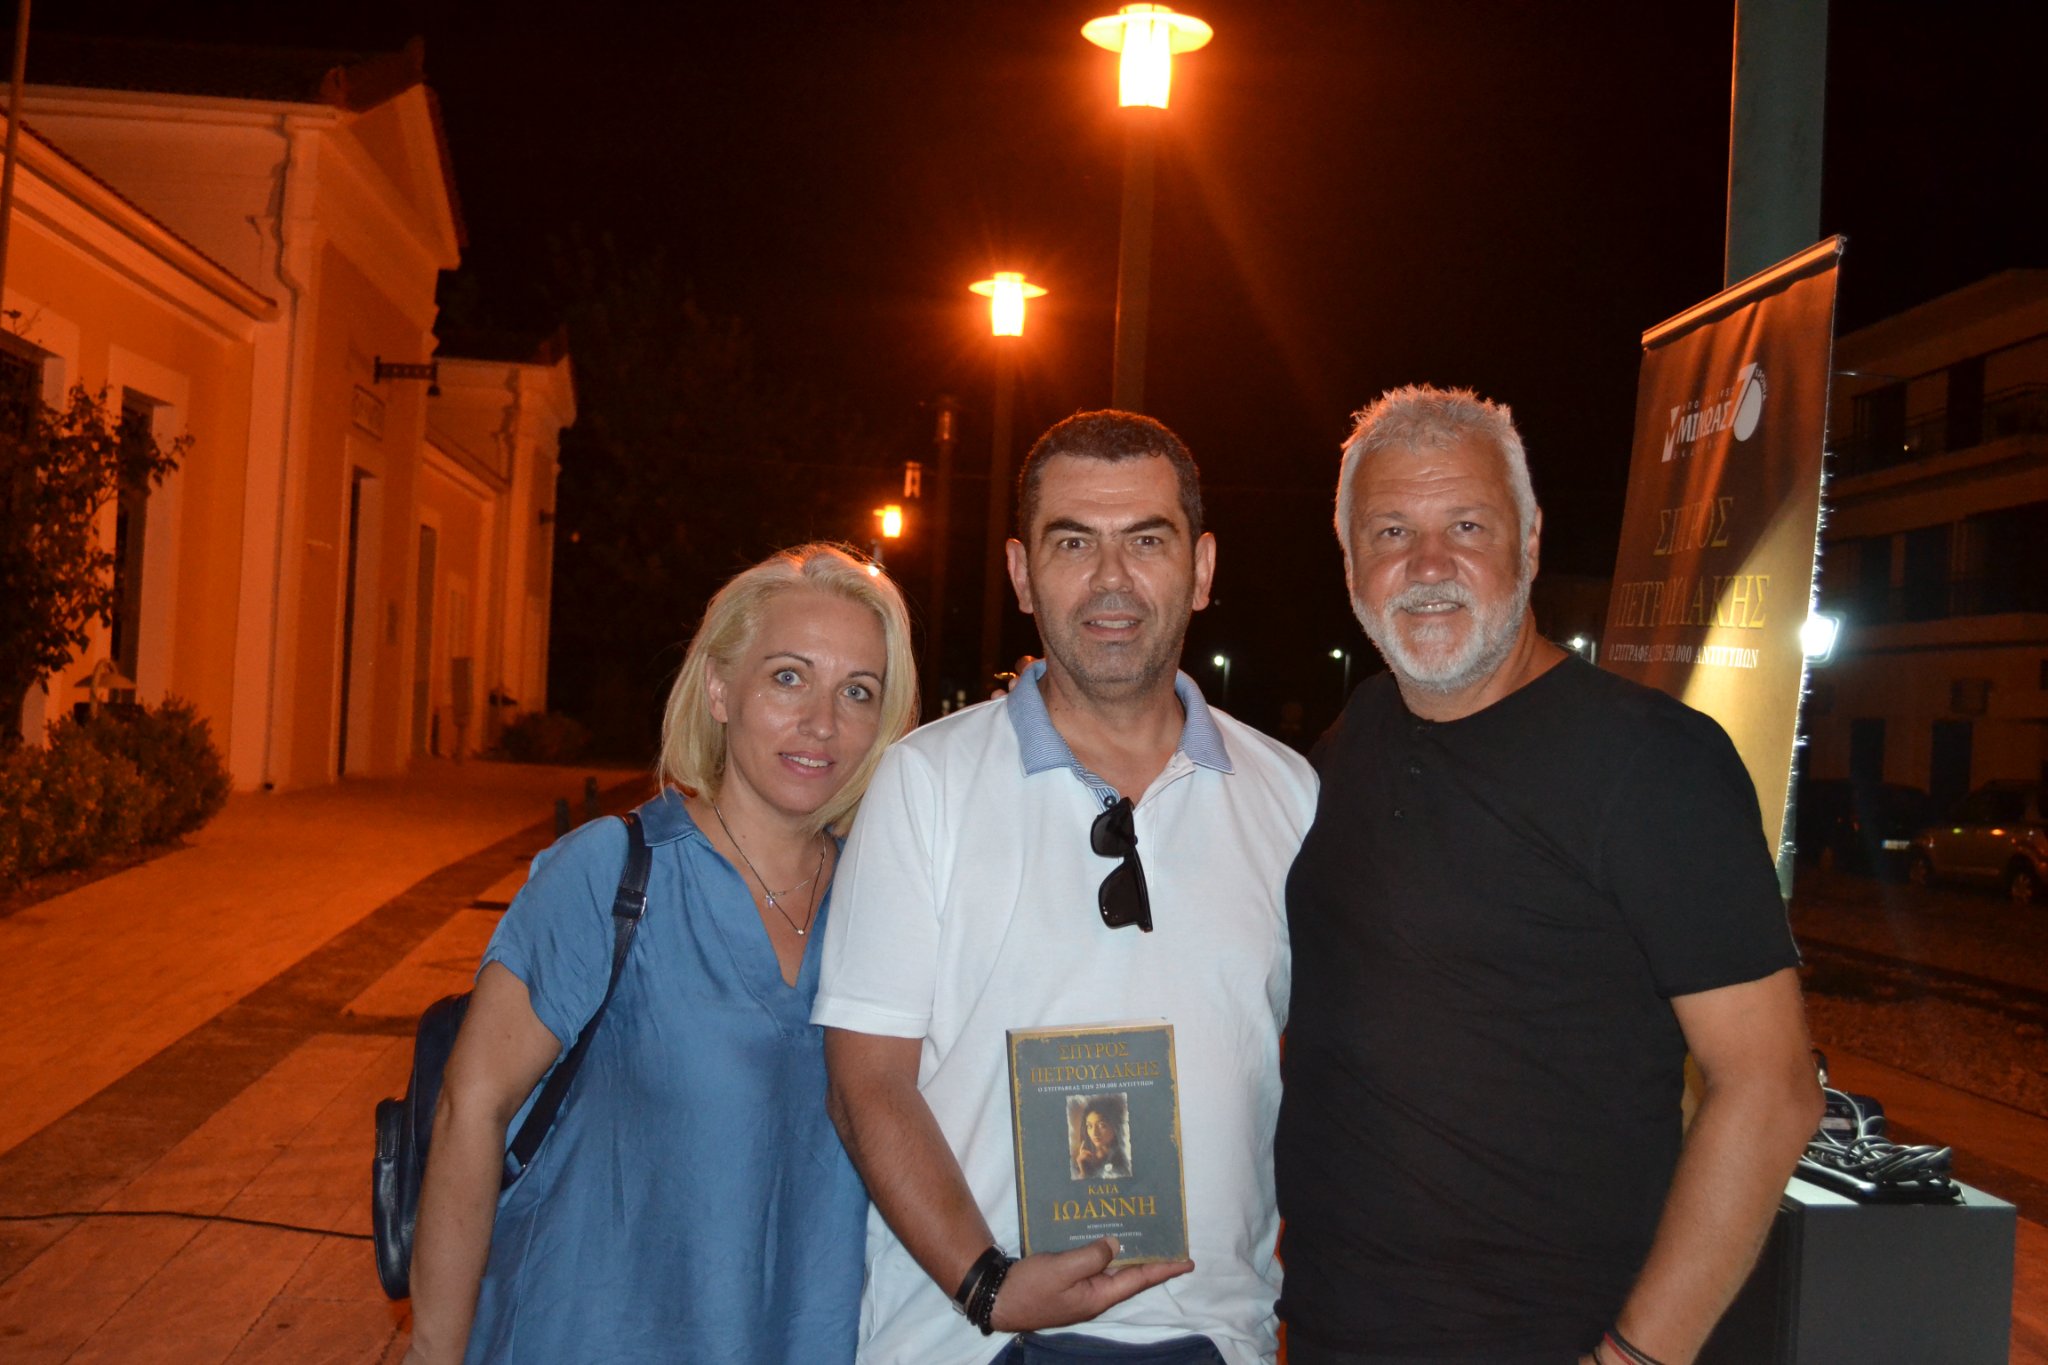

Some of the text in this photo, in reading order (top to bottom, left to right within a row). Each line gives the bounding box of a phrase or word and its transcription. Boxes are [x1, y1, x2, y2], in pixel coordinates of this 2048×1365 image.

[1676, 400, 1731, 444] ΜΙΝΩΑΣ
[1059, 1042, 1129, 1060] ΣΠΥΡΟΣ
[1030, 1061, 1160, 1083] ΠΕΤΡΟΥΛΑΚΗΣ
[1088, 1183, 1119, 1195] ΚΑΤΑ
[1053, 1195, 1157, 1221] ΙΩΑΝΝΗ
